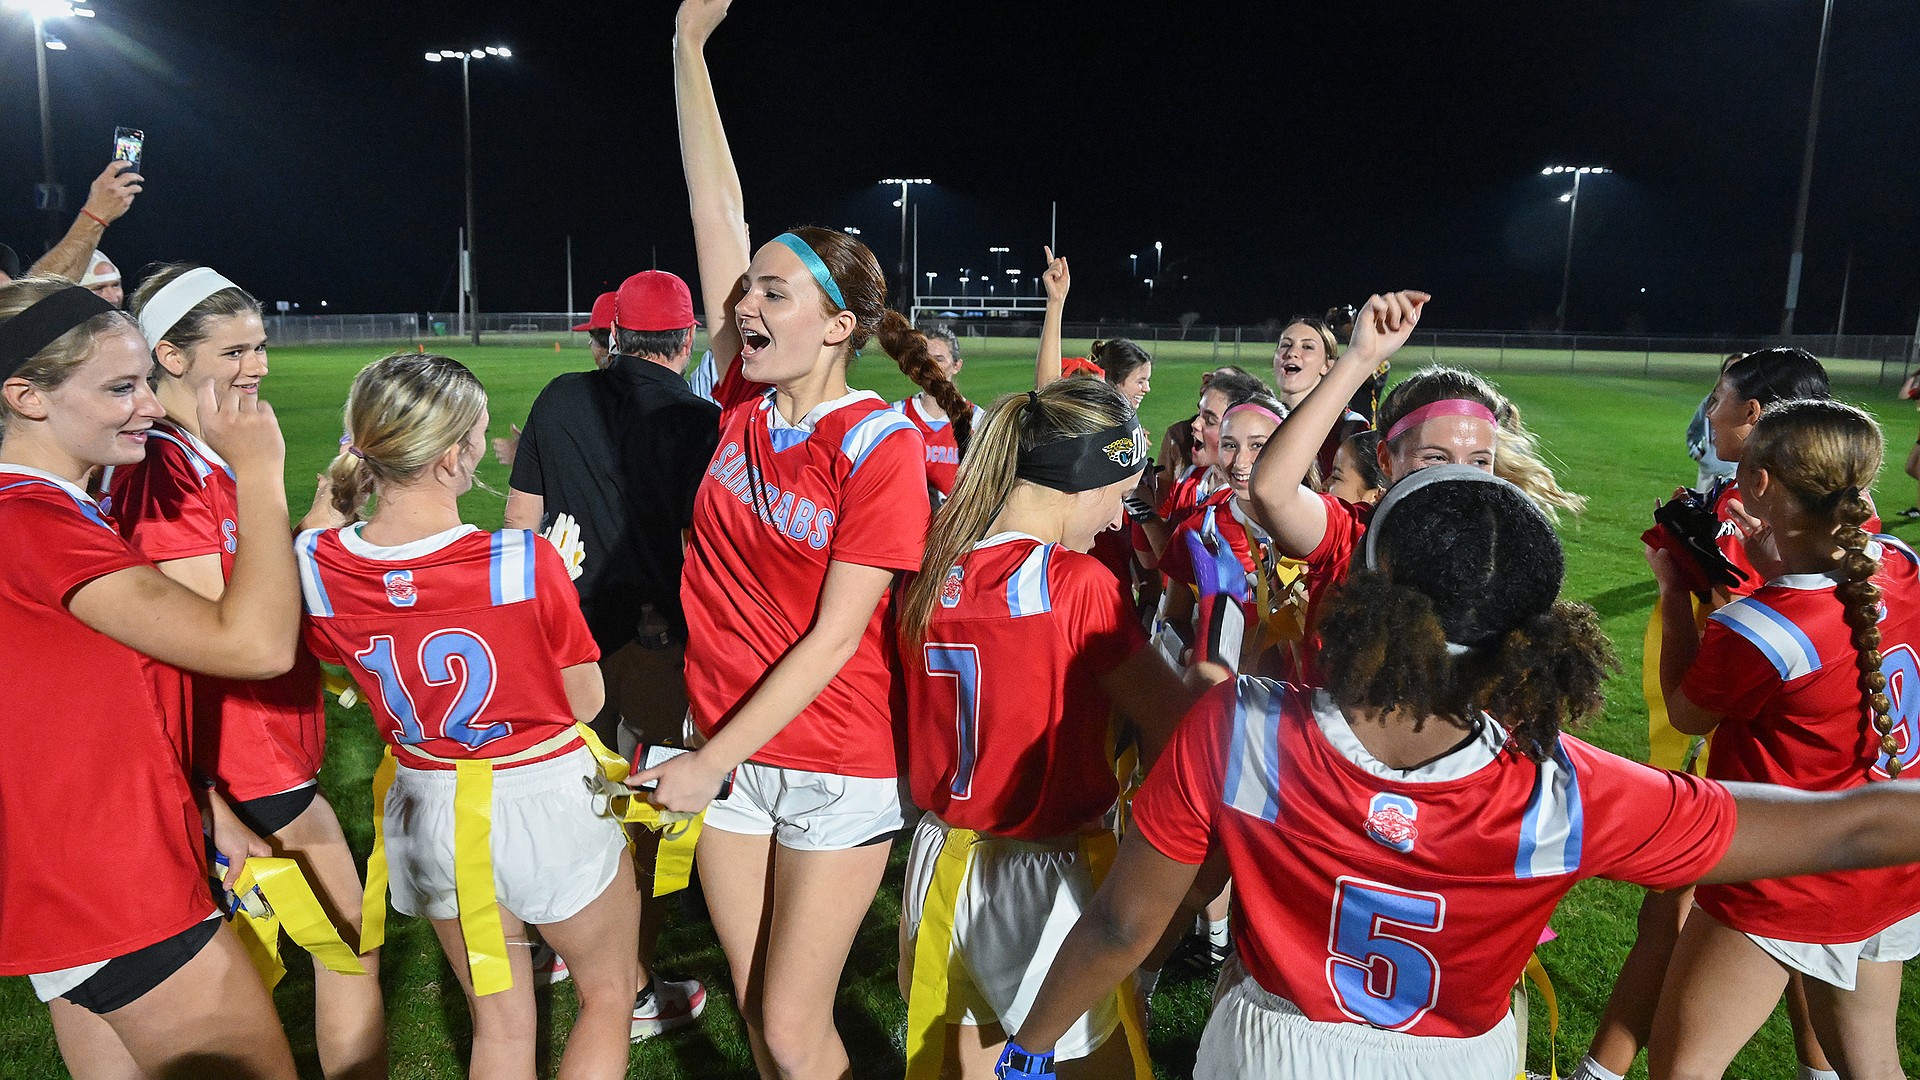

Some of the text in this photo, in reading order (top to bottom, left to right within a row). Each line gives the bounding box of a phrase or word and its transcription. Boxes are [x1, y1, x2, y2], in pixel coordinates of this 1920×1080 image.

[354, 627, 513, 751] 12
[924, 642, 982, 801] 7
[1325, 875, 1446, 1032] 5
